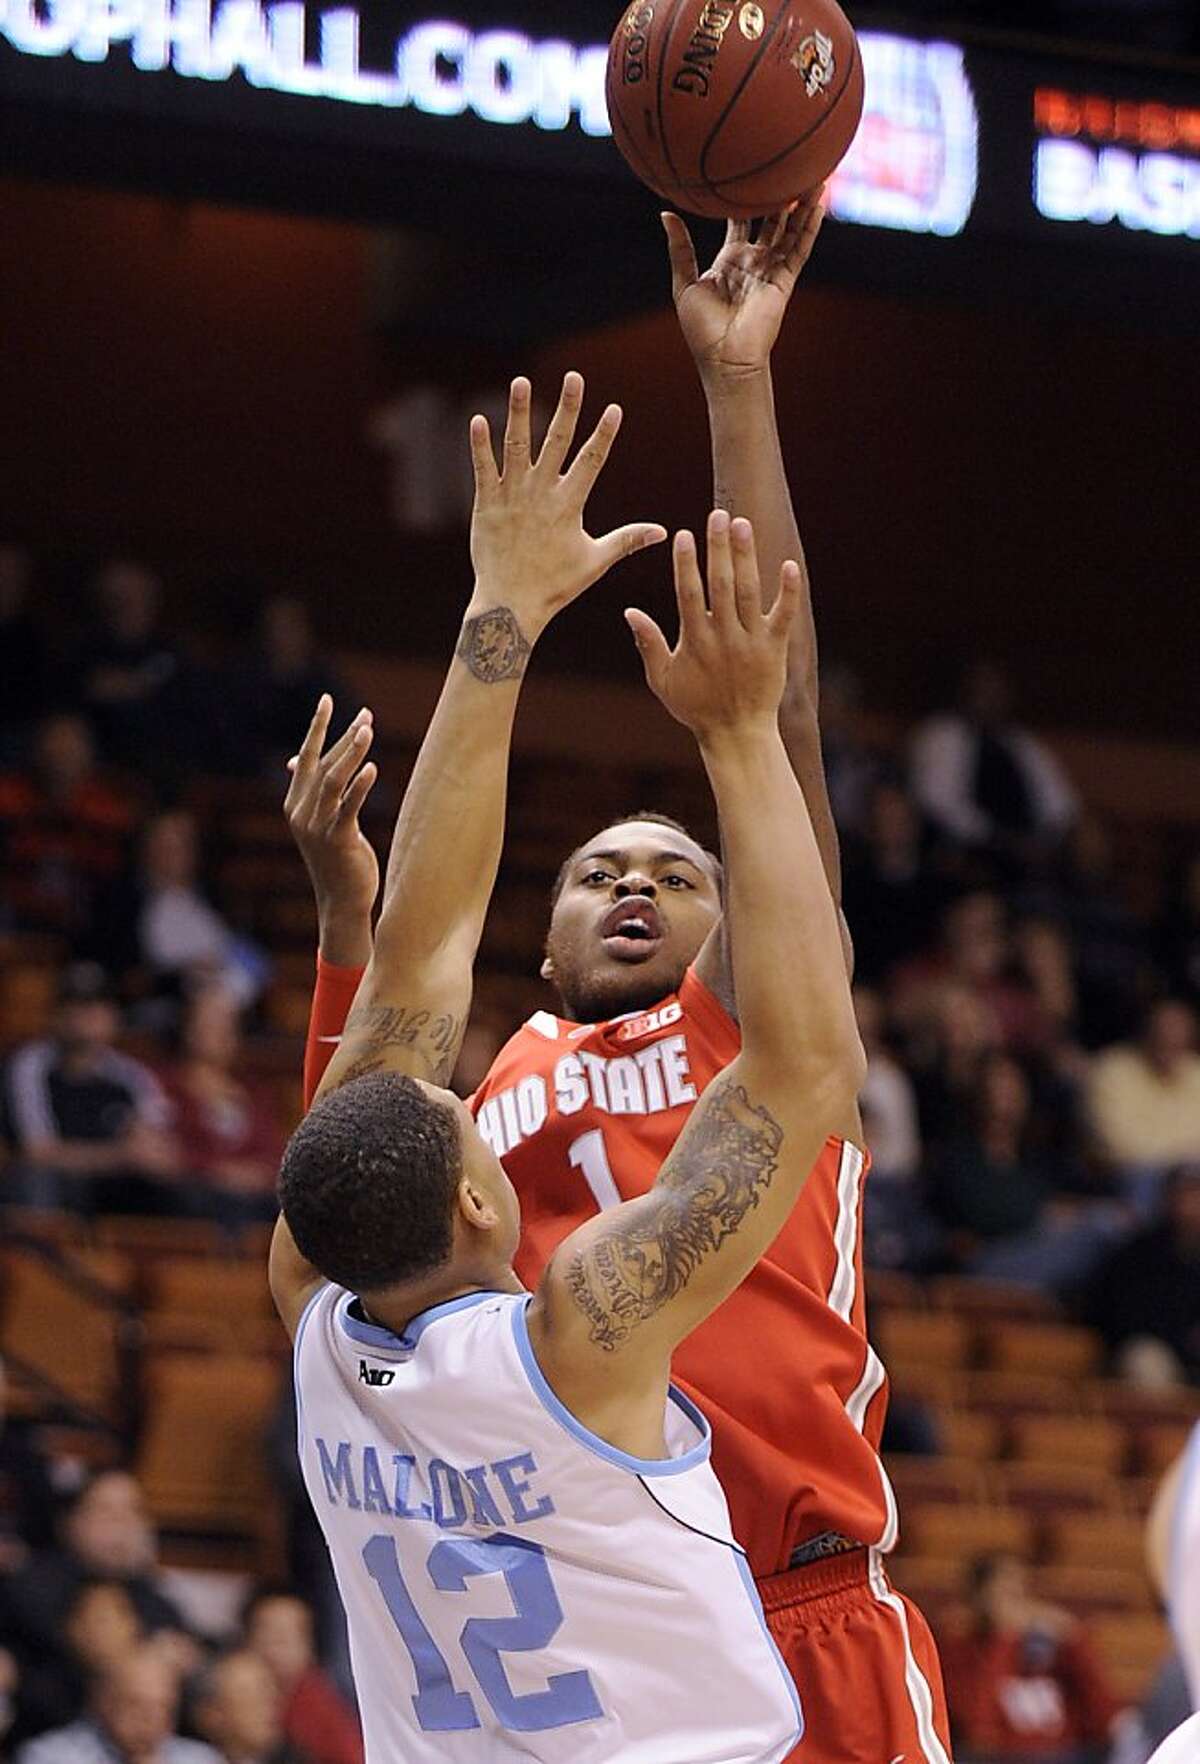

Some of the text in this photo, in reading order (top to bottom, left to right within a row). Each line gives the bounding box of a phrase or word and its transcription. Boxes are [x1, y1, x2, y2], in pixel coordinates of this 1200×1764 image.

[476, 1074, 549, 1158] HIO
[554, 1034, 697, 1116] STATE
[568, 1128, 623, 1212] 1
[315, 1437, 556, 1528] MALONE
[362, 1532, 605, 1732] 12
